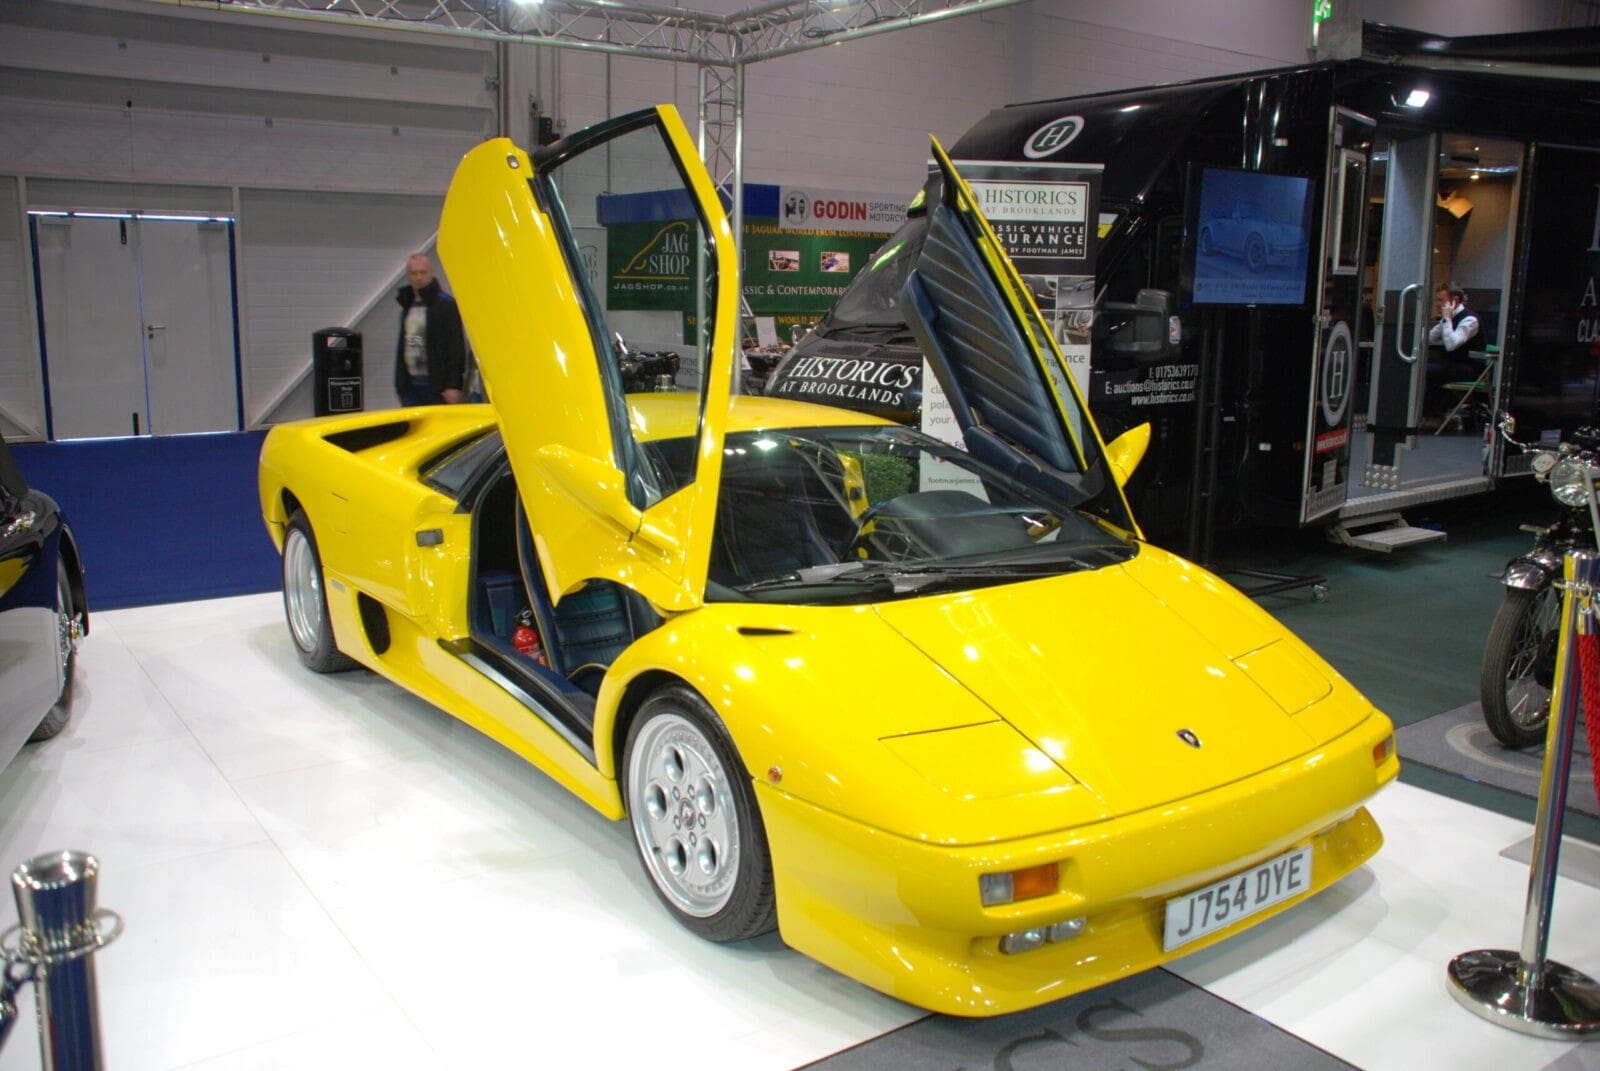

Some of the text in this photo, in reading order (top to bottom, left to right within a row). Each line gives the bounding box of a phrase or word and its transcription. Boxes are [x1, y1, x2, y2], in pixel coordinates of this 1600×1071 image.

[1035, 126, 1073, 148] H
[985, 188, 1078, 206] HISTORICS
[813, 199, 868, 221] GODIN
[869, 202, 907, 213] SPORTING
[984, 206, 1077, 216] AT BROOKLANDS
[751, 224, 783, 235] JAGUAR
[785, 227, 814, 236] WORLD
[1031, 224, 1085, 235] VEHICLE
[662, 232, 689, 254] JAG
[996, 233, 1085, 246] SURANCE
[1010, 246, 1020, 254] BY
[1022, 247, 1058, 255] FOOTMAN
[1060, 248, 1084, 256] JAMES
[649, 253, 691, 275] SHOP
[767, 284, 775, 295] &
[778, 315, 807, 324] WORLD
[787, 356, 921, 389] HISTORICS
[779, 381, 904, 406] AT BROOKLANDS
[929, 416, 951, 427] your
[1177, 852, 1304, 937] J754 DYE
